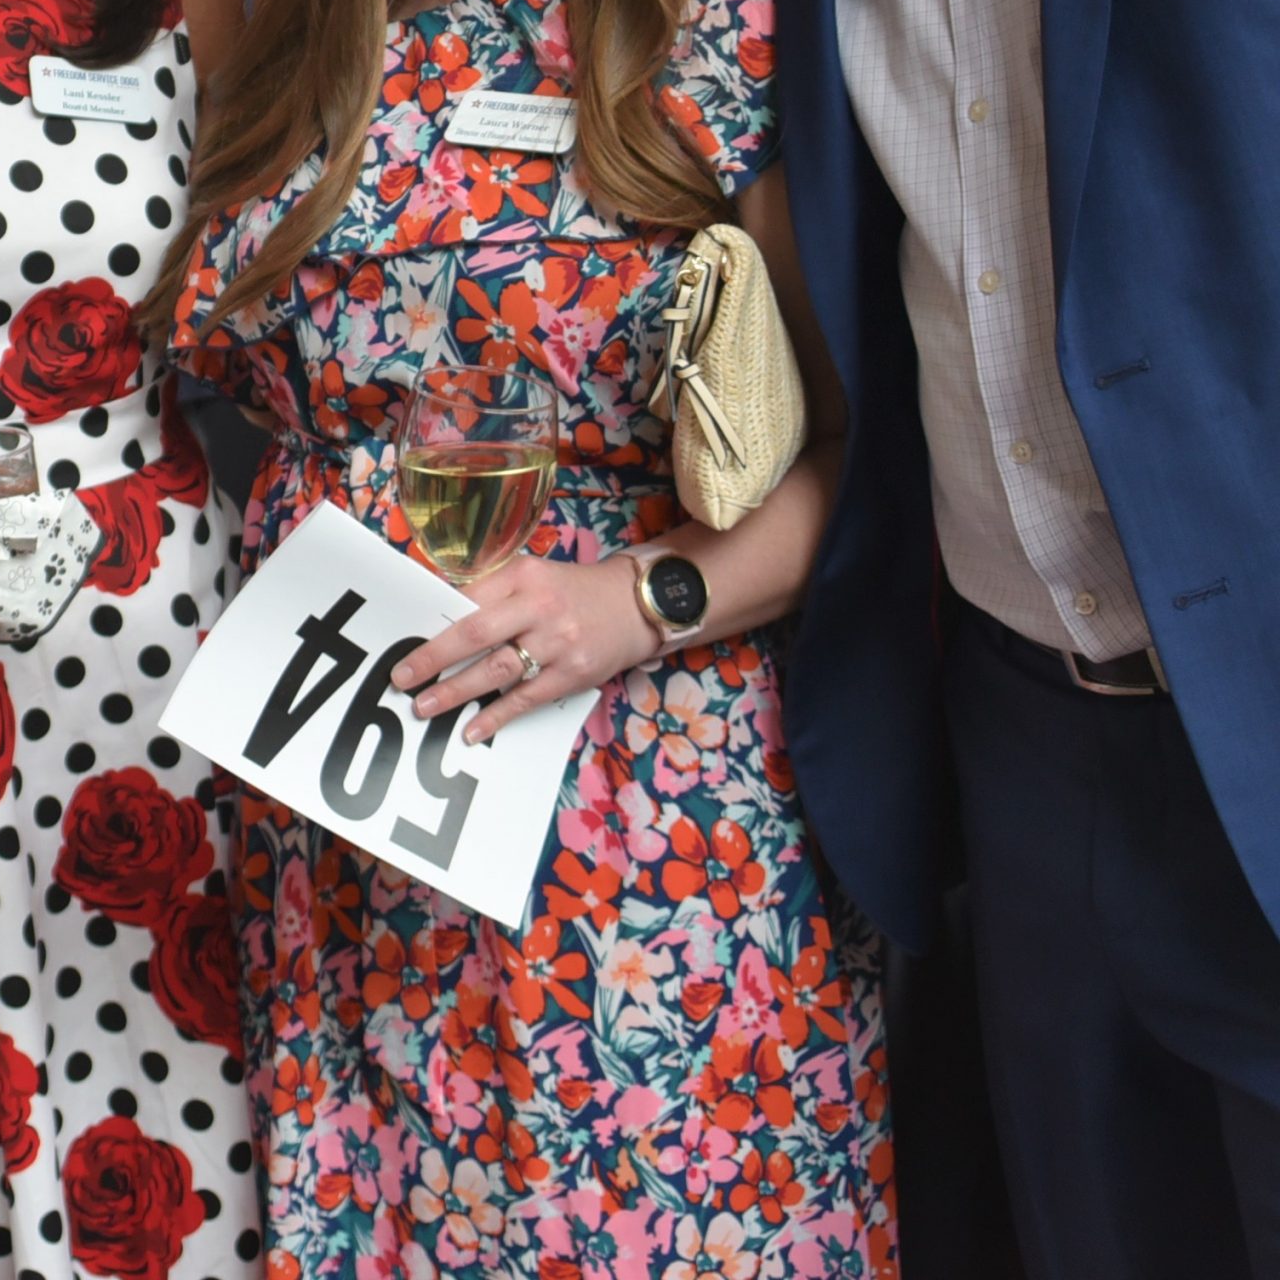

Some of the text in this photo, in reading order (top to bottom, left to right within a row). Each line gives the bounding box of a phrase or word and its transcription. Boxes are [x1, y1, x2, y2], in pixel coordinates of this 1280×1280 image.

[53, 69, 140, 87] FREEDOM SERVICE DOGS
[62, 102, 125, 115] Board Member
[482, 101, 519, 111] FREEDOM
[520, 104, 552, 115] SERVICE
[480, 117, 508, 128] Laura
[242, 588, 505, 872] 594
